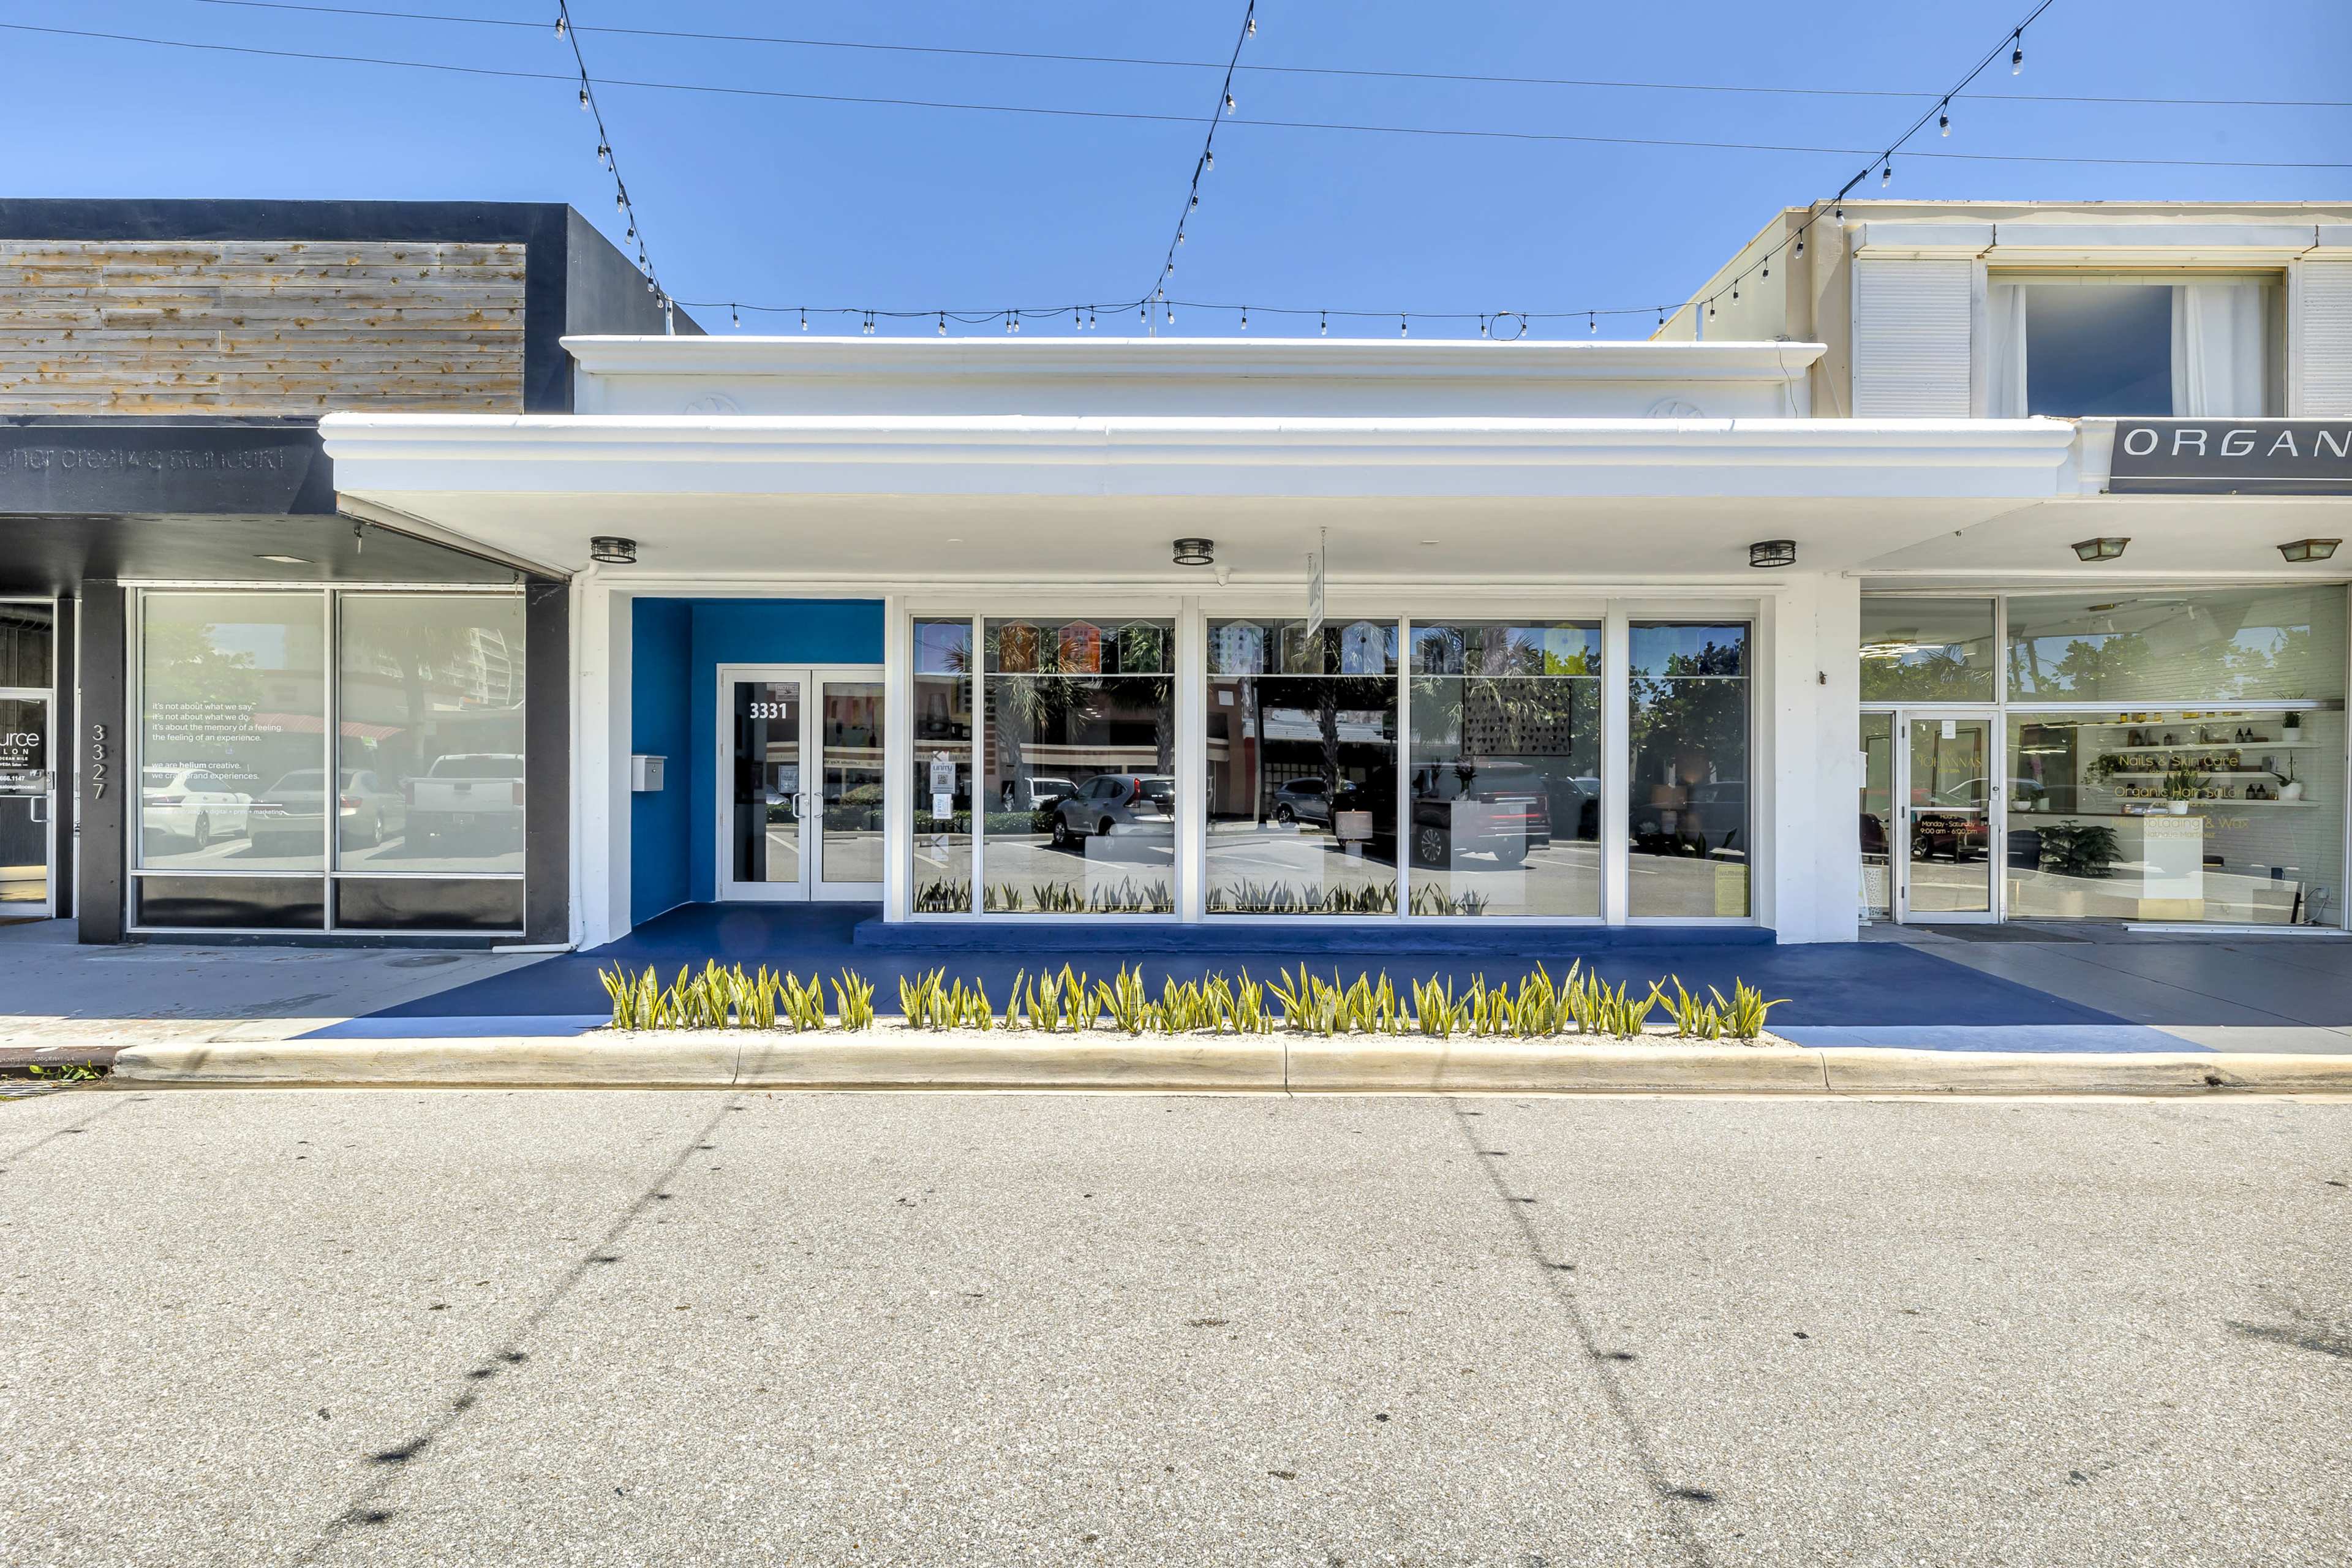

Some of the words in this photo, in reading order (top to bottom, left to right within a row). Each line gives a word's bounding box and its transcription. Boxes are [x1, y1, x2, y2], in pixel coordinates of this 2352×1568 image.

[2124, 428, 2352, 458] ORGAN
[750, 703, 786, 719] 3331
[255, 724, 284, 733] feeling.
[0, 733, 40, 747] urce
[92, 725, 104, 799] 3327
[2119, 755, 2154, 766] Nails
[2158, 756, 2168, 766] &
[2171, 755, 2199, 766] Skin
[2204, 755, 2239, 766] Care
[2114, 786, 2169, 799] Organic
[2173, 786, 2198, 797] Hair
[2205, 818, 2215, 827] &
